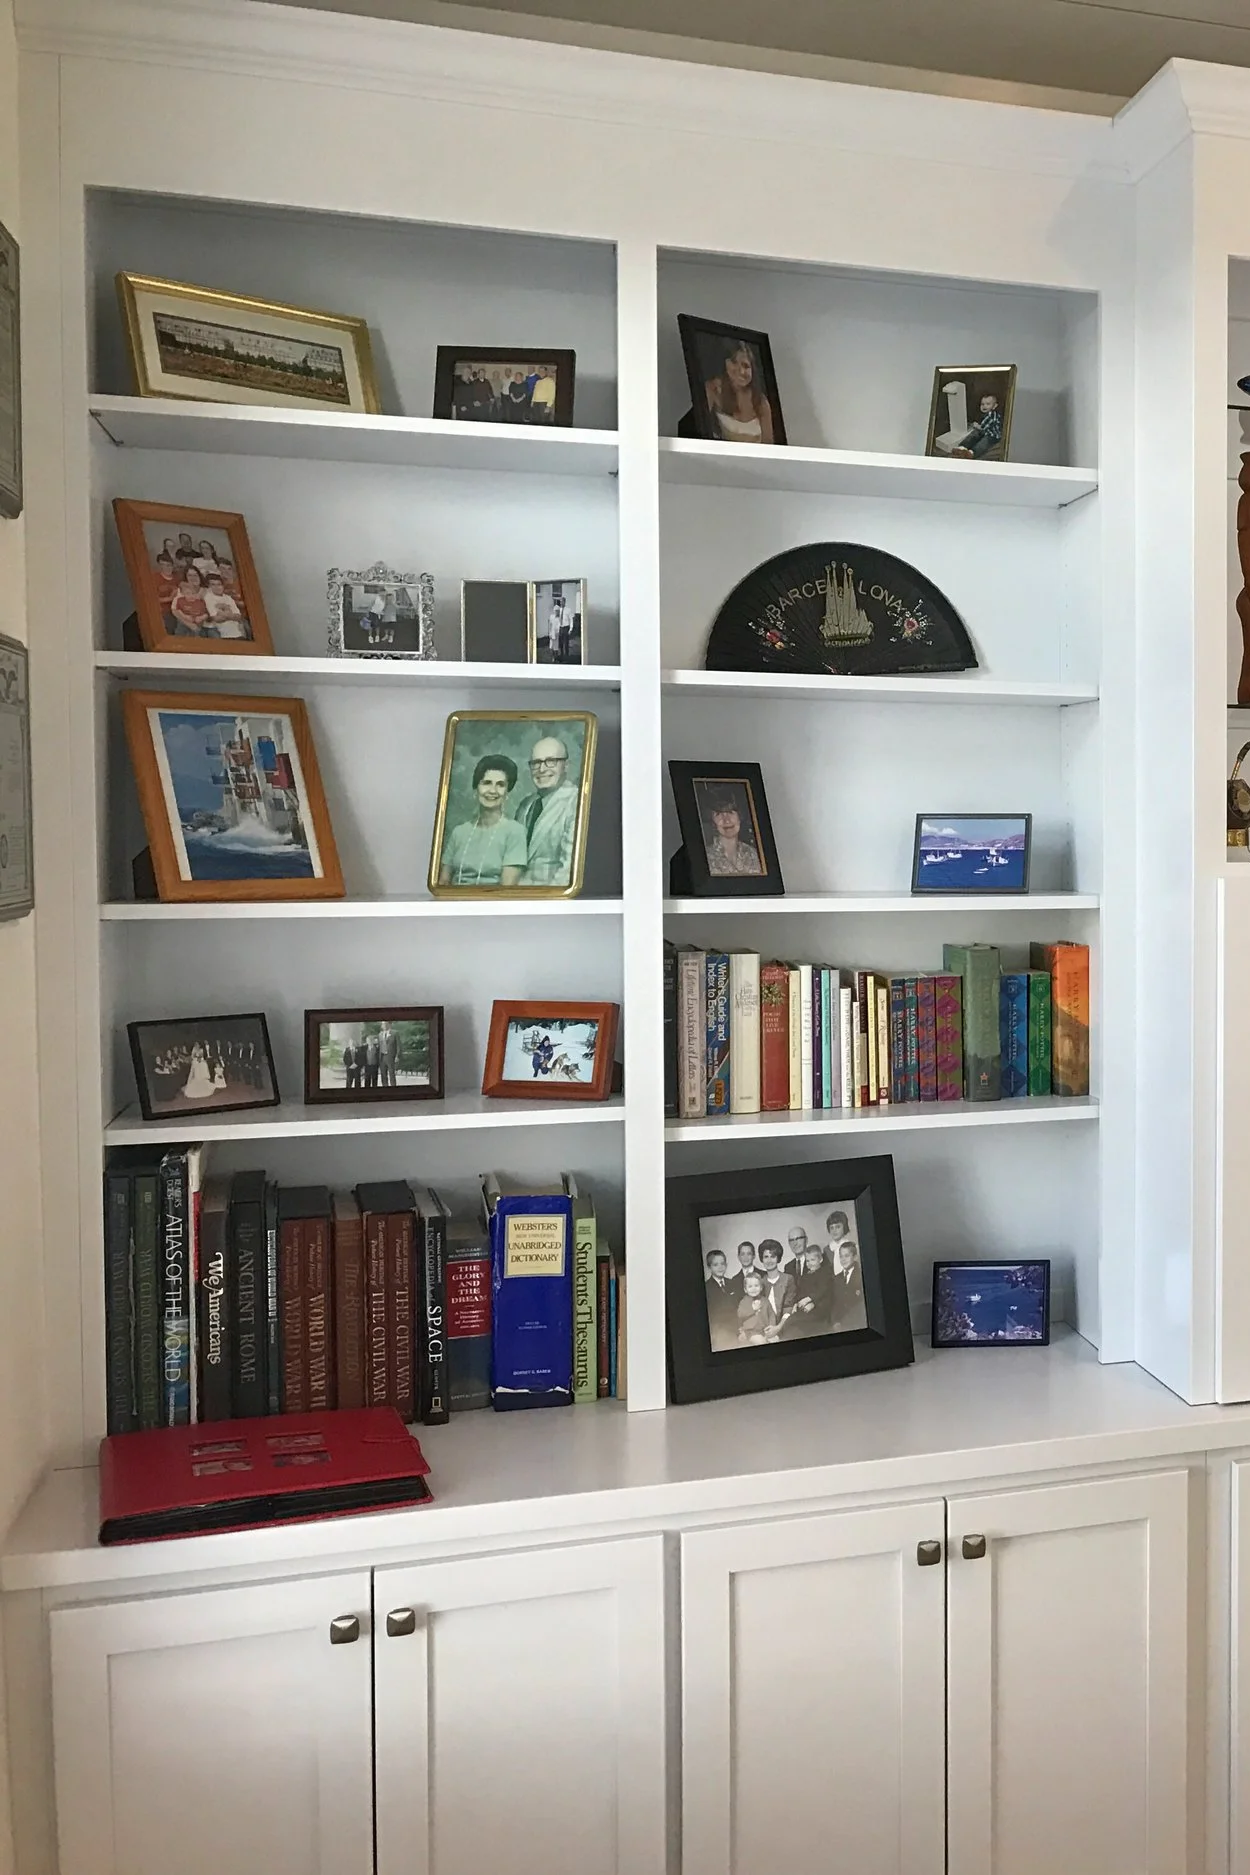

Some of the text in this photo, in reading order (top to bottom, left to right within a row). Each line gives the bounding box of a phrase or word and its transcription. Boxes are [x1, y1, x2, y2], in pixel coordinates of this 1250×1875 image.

[706, 963, 717, 1032] Index to English
[717, 963, 727, 1041] Writer's Guide and
[687, 1055, 698, 1081] Letters
[164, 1214, 183, 1261] ATLAS
[427, 1227, 435, 1290] ENCYCLOPEDIA
[508, 1242, 562, 1250] UNABRIDGED
[511, 1253, 560, 1263] DICTIONARY
[140, 1249, 153, 1280] WAR
[164, 1263, 183, 1287] OF
[452, 1272, 485, 1280] GLORY
[458, 1280, 480, 1288] AND
[140, 1281, 154, 1327] WORLD
[163, 1287, 183, 1319] THE
[202, 1251, 225, 1365] We Americans
[238, 1248, 257, 1384] ANCIENT ROME
[284, 1295, 302, 1355] WORLD
[451, 1295, 488, 1304] DREAM
[575, 1241, 593, 1388] Students Thesaurus
[140, 1333, 154, 1384] SECOND
[163, 1320, 182, 1382] WORLD
[308, 1292, 326, 1407] WORLD WAR II
[371, 1289, 386, 1401] THE CIVIL WAR
[395, 1287, 410, 1400] THE CIVIL WAR
[427, 1305, 443, 1364] SPACE
[285, 1359, 302, 1396] WAR
